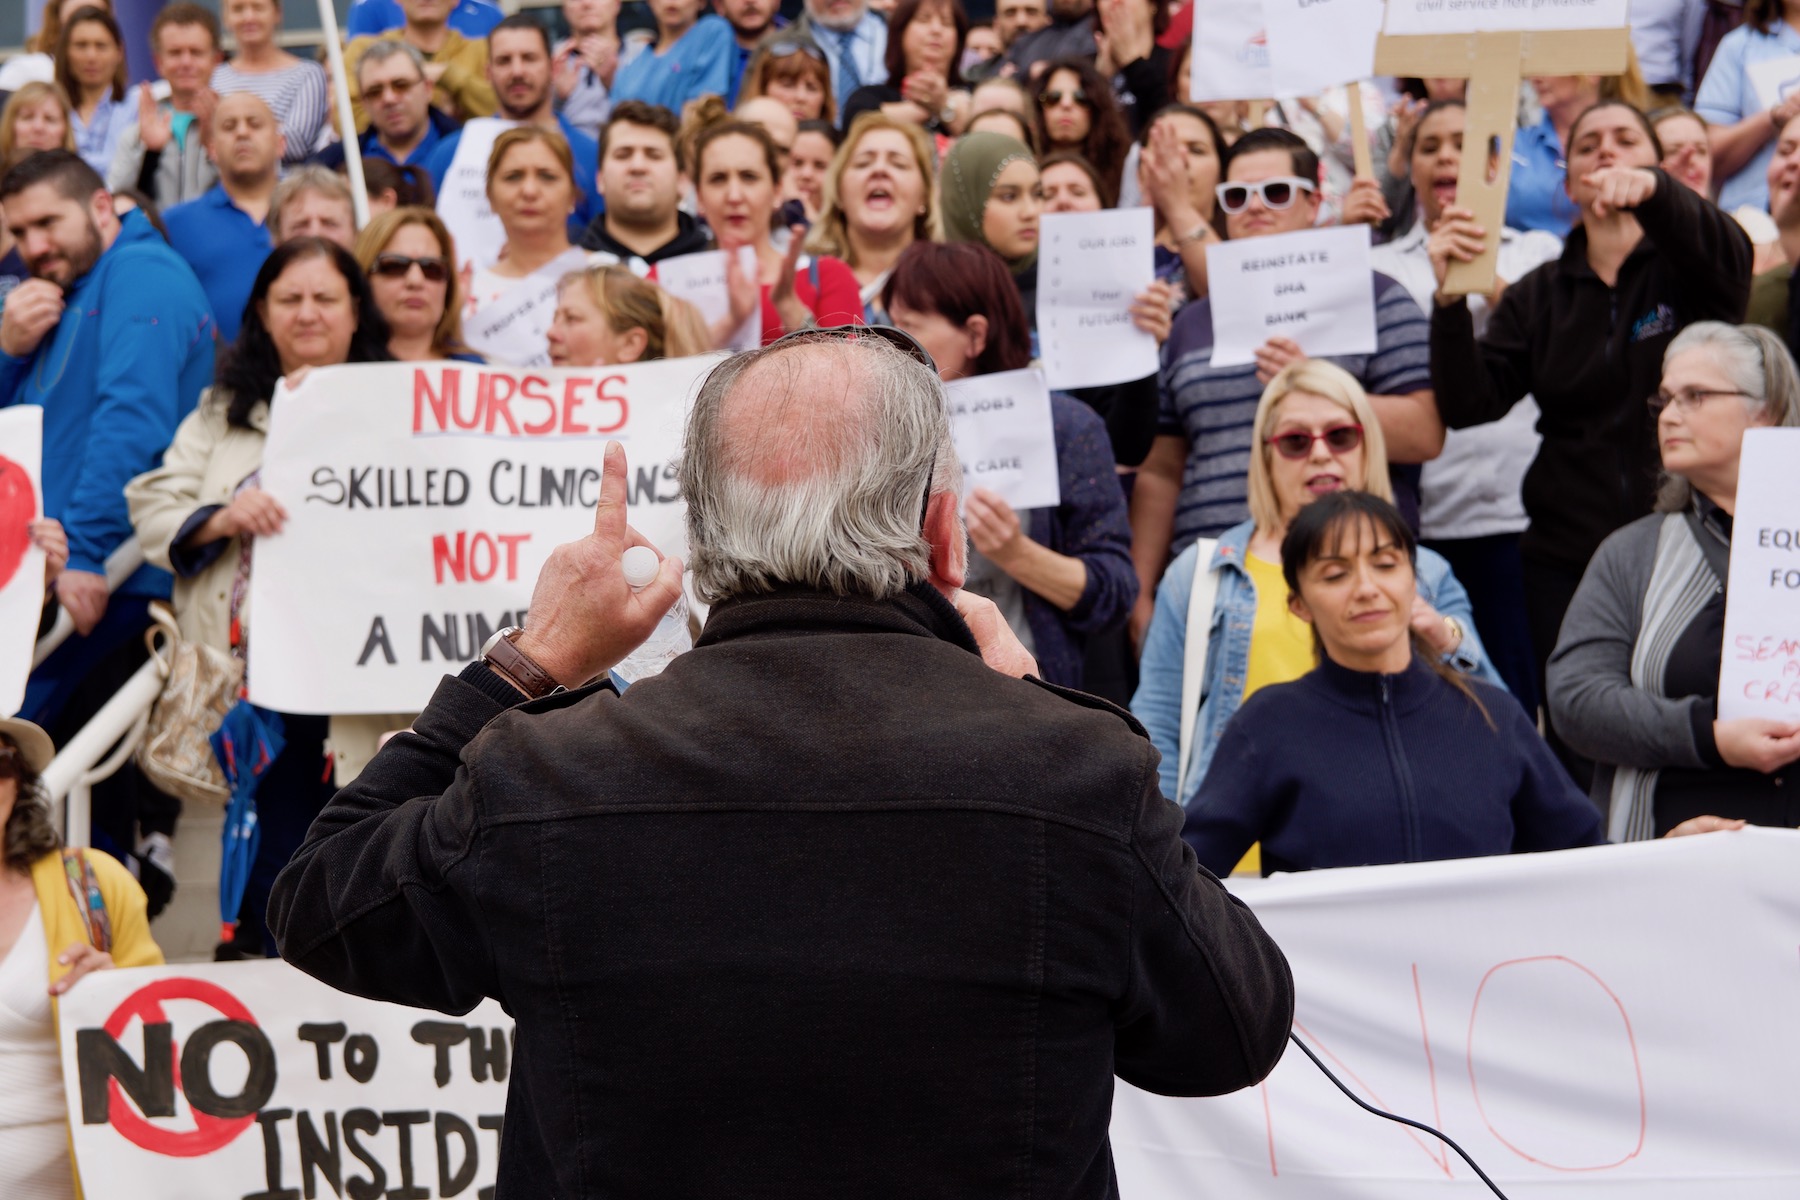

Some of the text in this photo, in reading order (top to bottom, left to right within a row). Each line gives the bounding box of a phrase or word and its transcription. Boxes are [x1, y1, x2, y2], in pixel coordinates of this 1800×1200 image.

[1241, 250, 1329, 273] REINSTATE
[412, 368, 630, 435] NURSES
[972, 397, 1015, 412] JOBS
[306, 460, 681, 508] SKILLED CLINICNS
[975, 456, 1022, 473] CARE
[433, 531, 531, 584] NOT
[356, 615, 397, 665] A
[76, 1019, 516, 1125] NO TO TH
[1260, 954, 1647, 1180] NO
